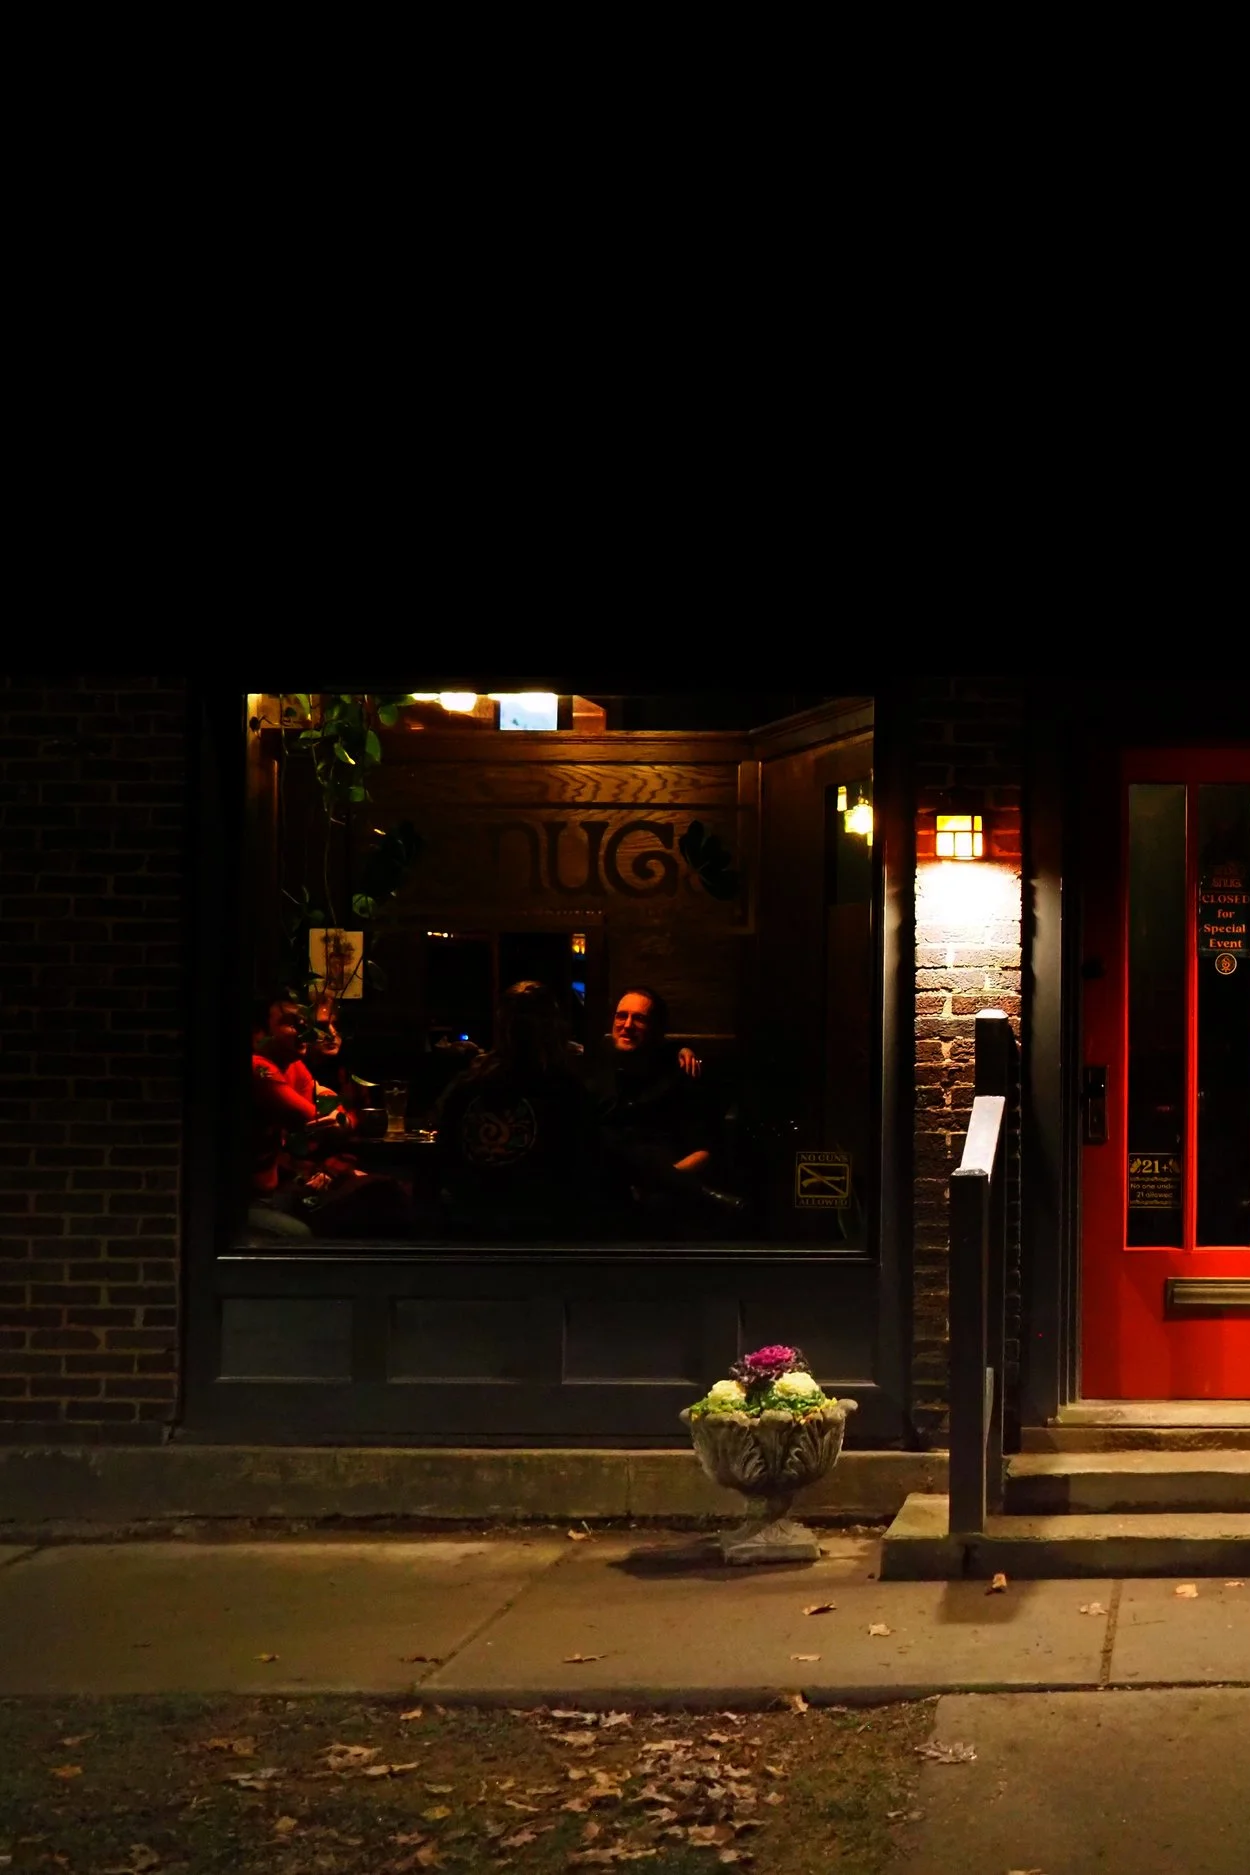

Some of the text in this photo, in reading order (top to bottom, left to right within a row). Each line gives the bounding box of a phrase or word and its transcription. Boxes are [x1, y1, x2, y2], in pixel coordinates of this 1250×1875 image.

[1202, 894, 1250, 904] CLOSED
[1217, 908, 1236, 919] for
[1203, 923, 1247, 935] Special
[1209, 938, 1243, 949] Event
[800, 1154, 816, 1162] NO
[1142, 1159, 1169, 1174] 21+
